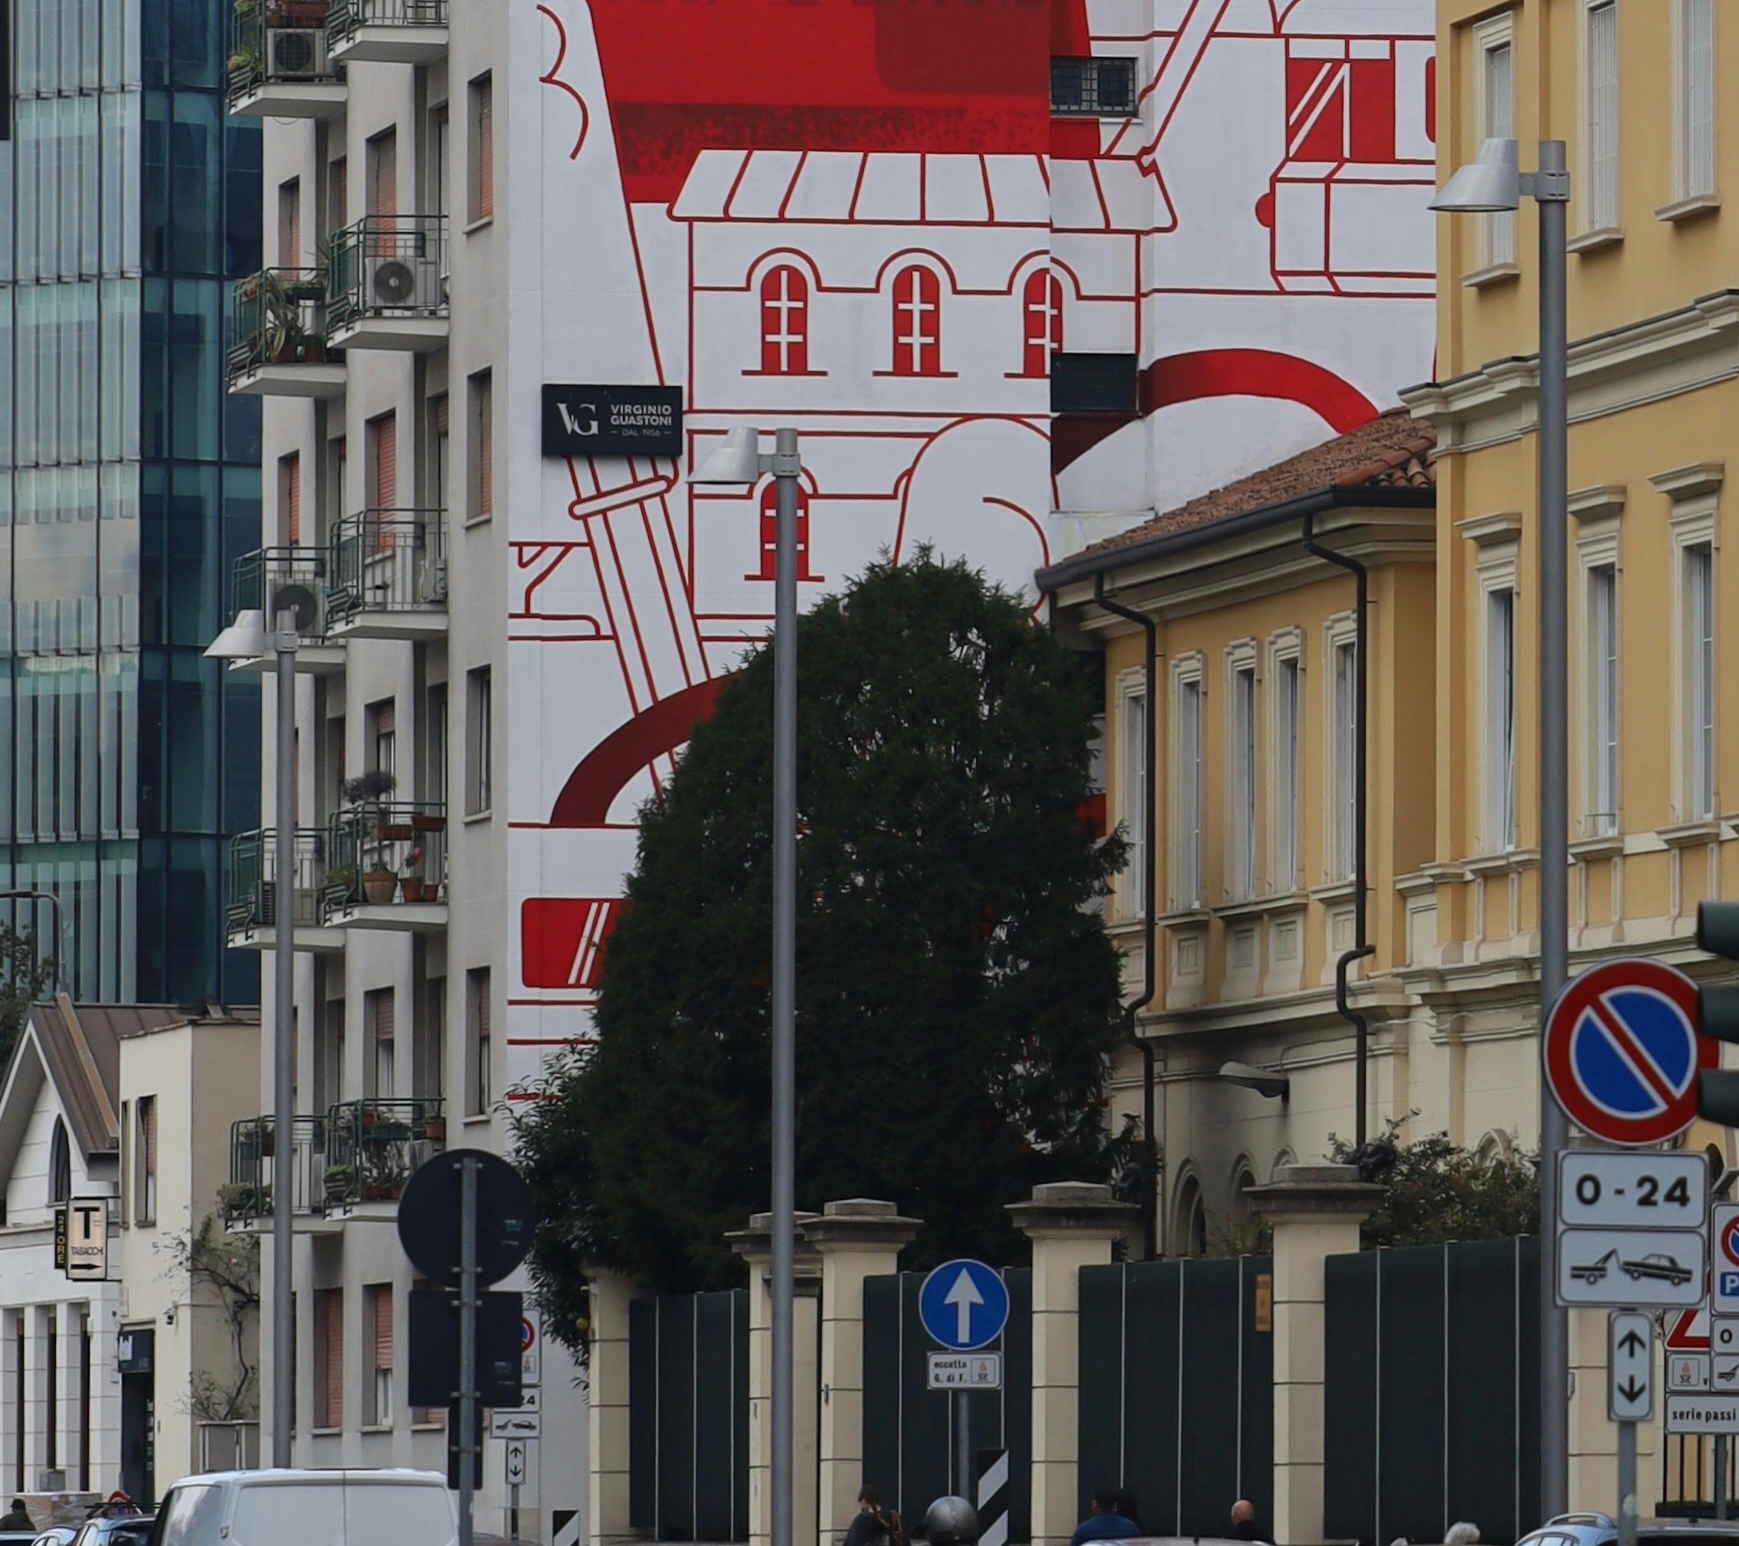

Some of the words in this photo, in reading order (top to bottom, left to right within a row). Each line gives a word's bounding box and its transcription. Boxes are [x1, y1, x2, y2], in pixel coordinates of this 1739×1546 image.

[610, 404, 672, 415] VIRGINIO
[610, 415, 672, 427] GUASTONI
[622, 428, 639, 437] DAL
[1576, 1174, 1602, 1207] 0
[1636, 1174, 1691, 1207] 24
[74, 1206, 100, 1239] T
[1672, 1408, 1702, 1421] serie
[1704, 1408, 1737, 1425] passi
